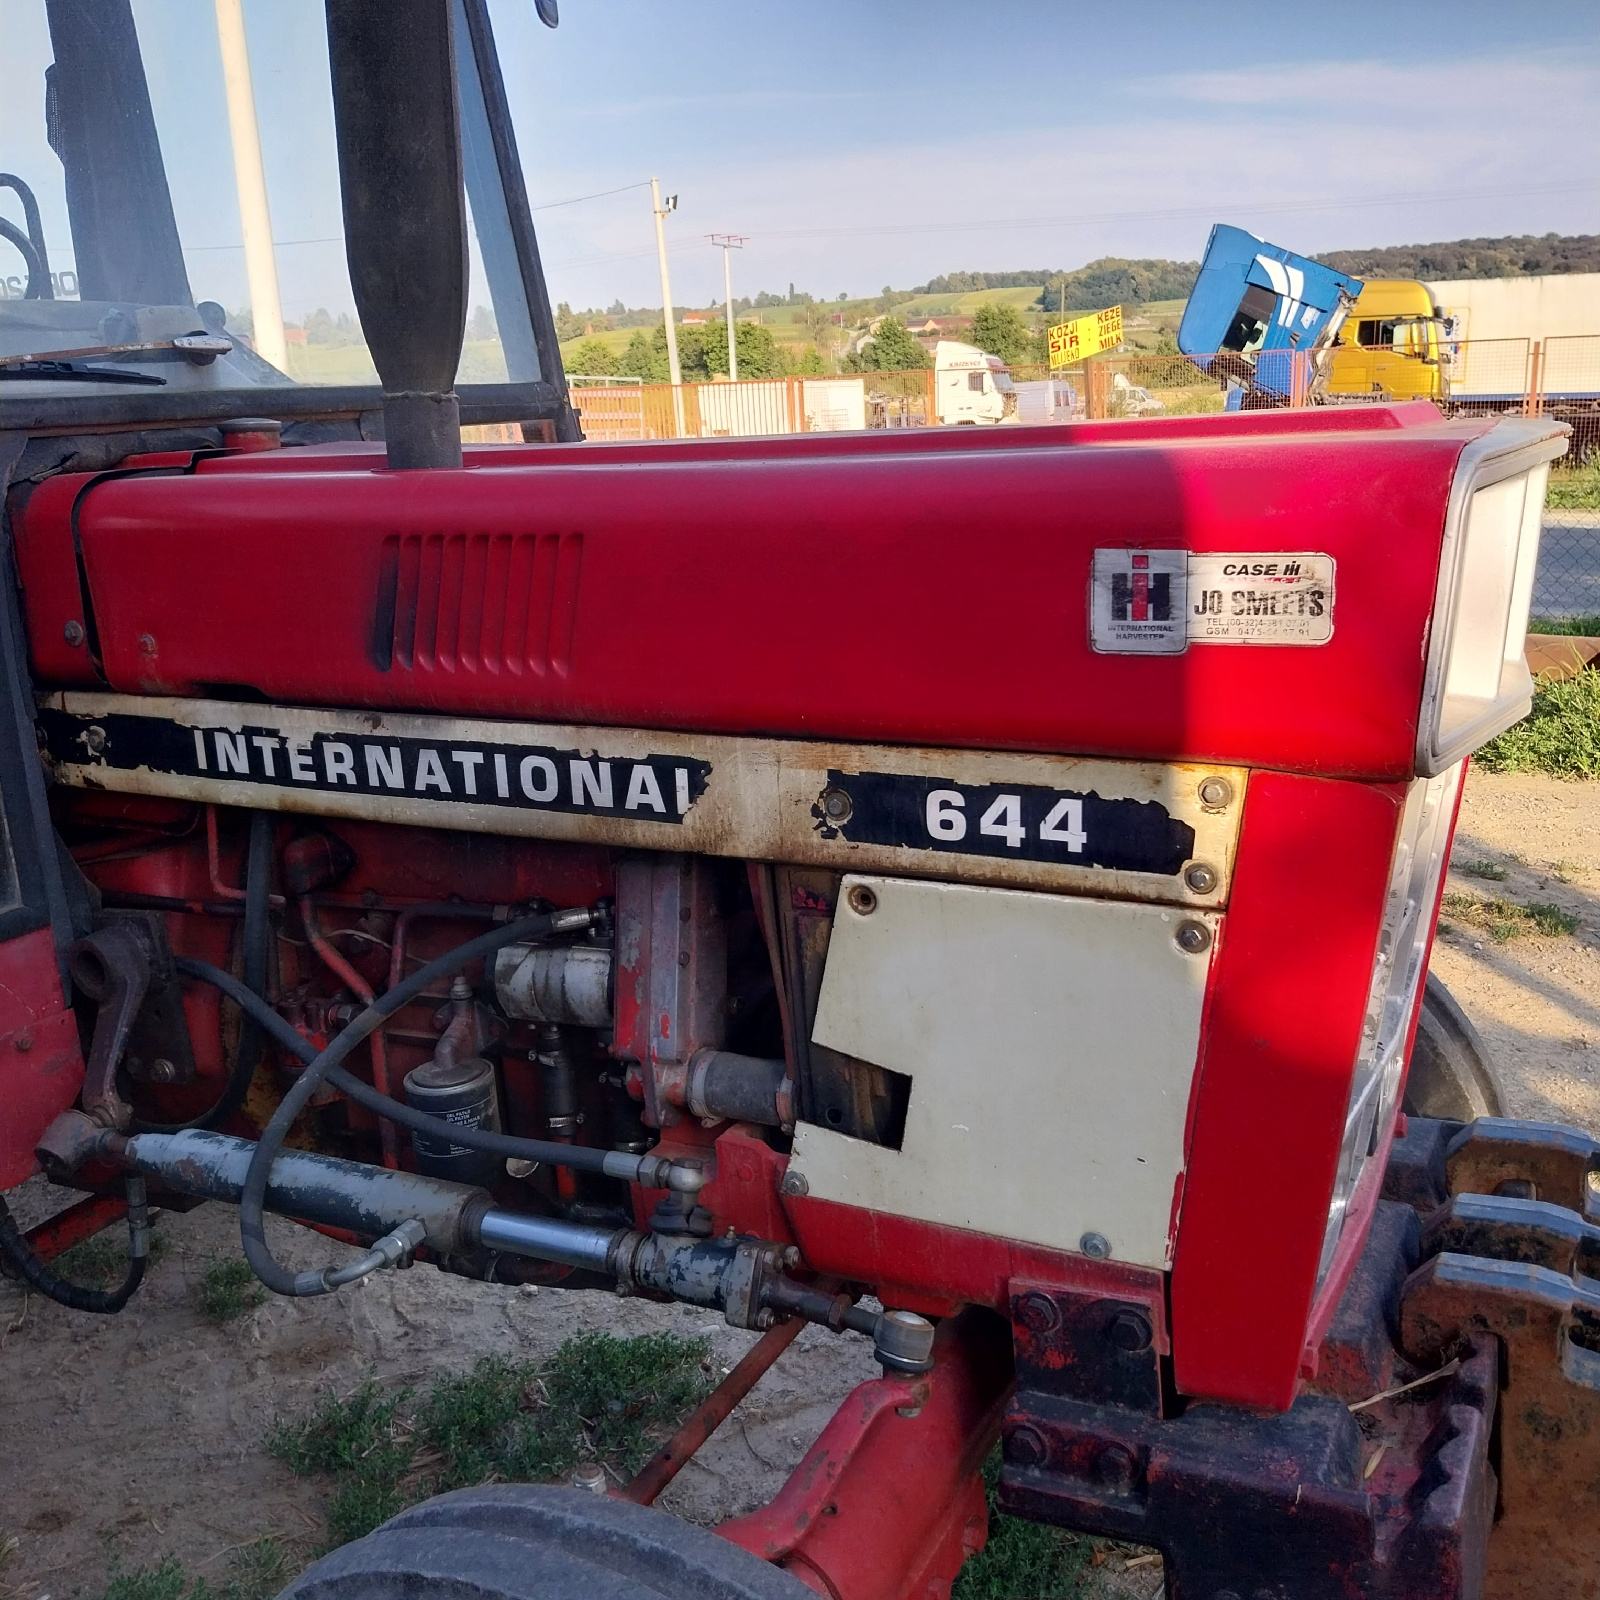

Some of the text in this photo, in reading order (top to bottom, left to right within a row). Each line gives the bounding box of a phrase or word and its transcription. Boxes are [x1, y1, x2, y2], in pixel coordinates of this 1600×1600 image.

[1049, 321, 1078, 341] KOZJI
[1050, 335, 1080, 353] SIR
[1223, 564, 1278, 576] CASE
[1194, 589, 1223, 615] JO
[1206, 627, 1229, 635] GSM
[925, 789, 1088, 853] 644
